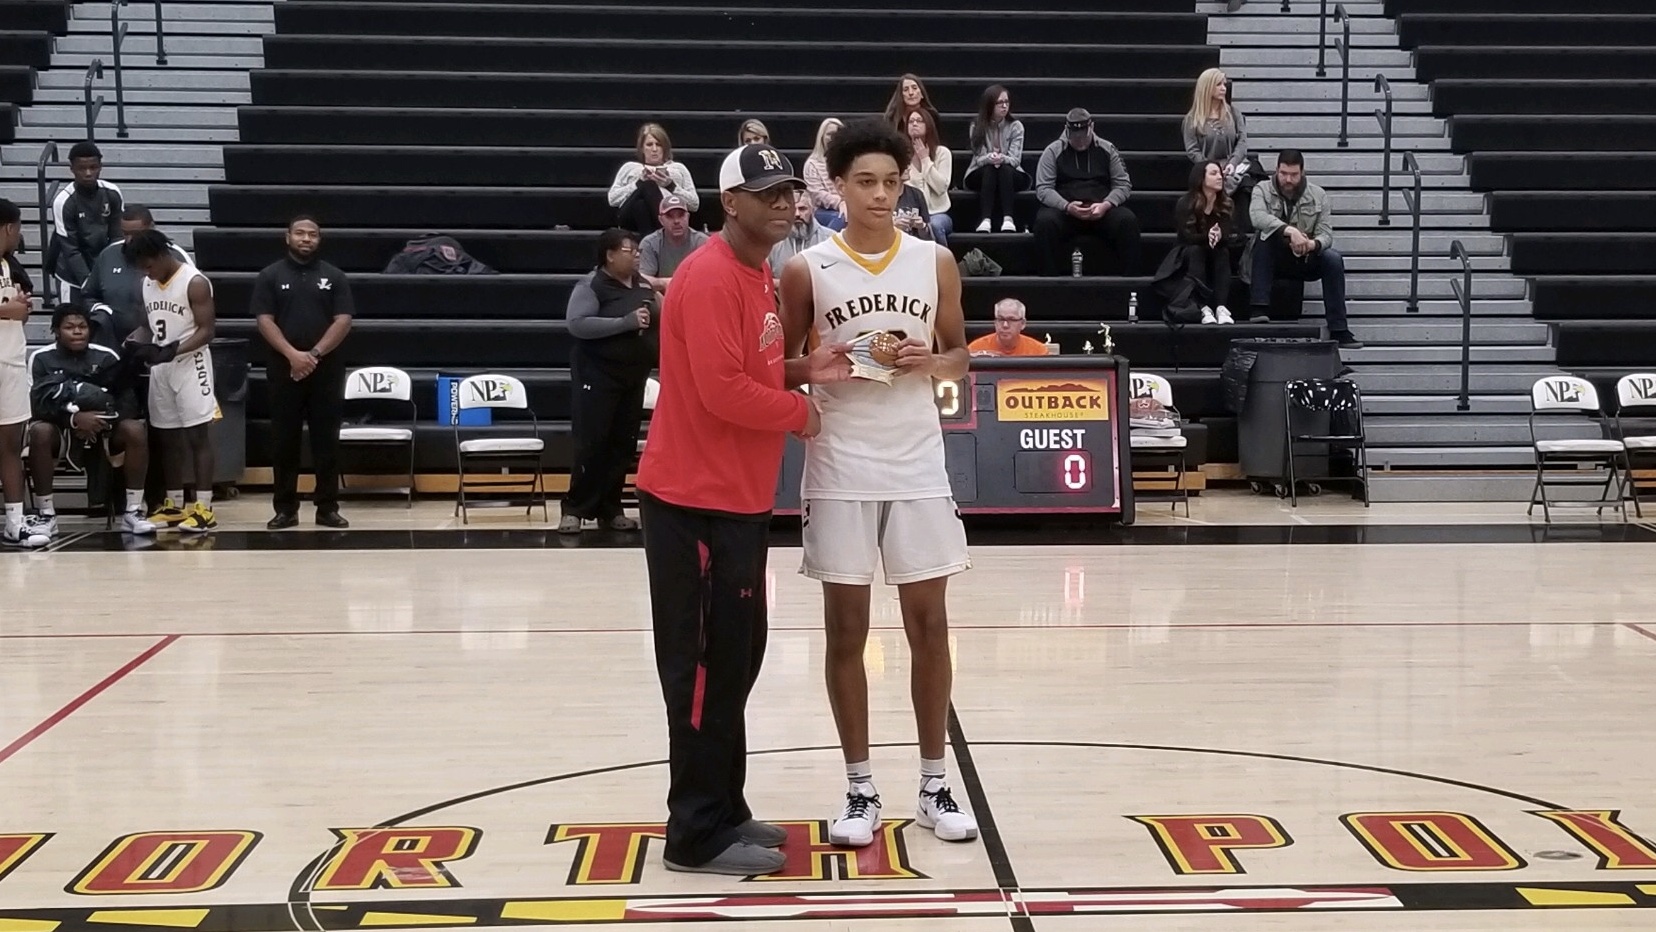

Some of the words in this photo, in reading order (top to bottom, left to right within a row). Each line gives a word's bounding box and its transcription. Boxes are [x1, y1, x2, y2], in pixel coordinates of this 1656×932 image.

[824, 293, 932, 331] FREDERICK
[155, 319, 167, 341] 3
[193, 351, 211, 396] CADETS
[1005, 395, 1102, 410] OUTBACK
[1020, 429, 1086, 449] GUEST
[1064, 454, 1086, 490] 0
